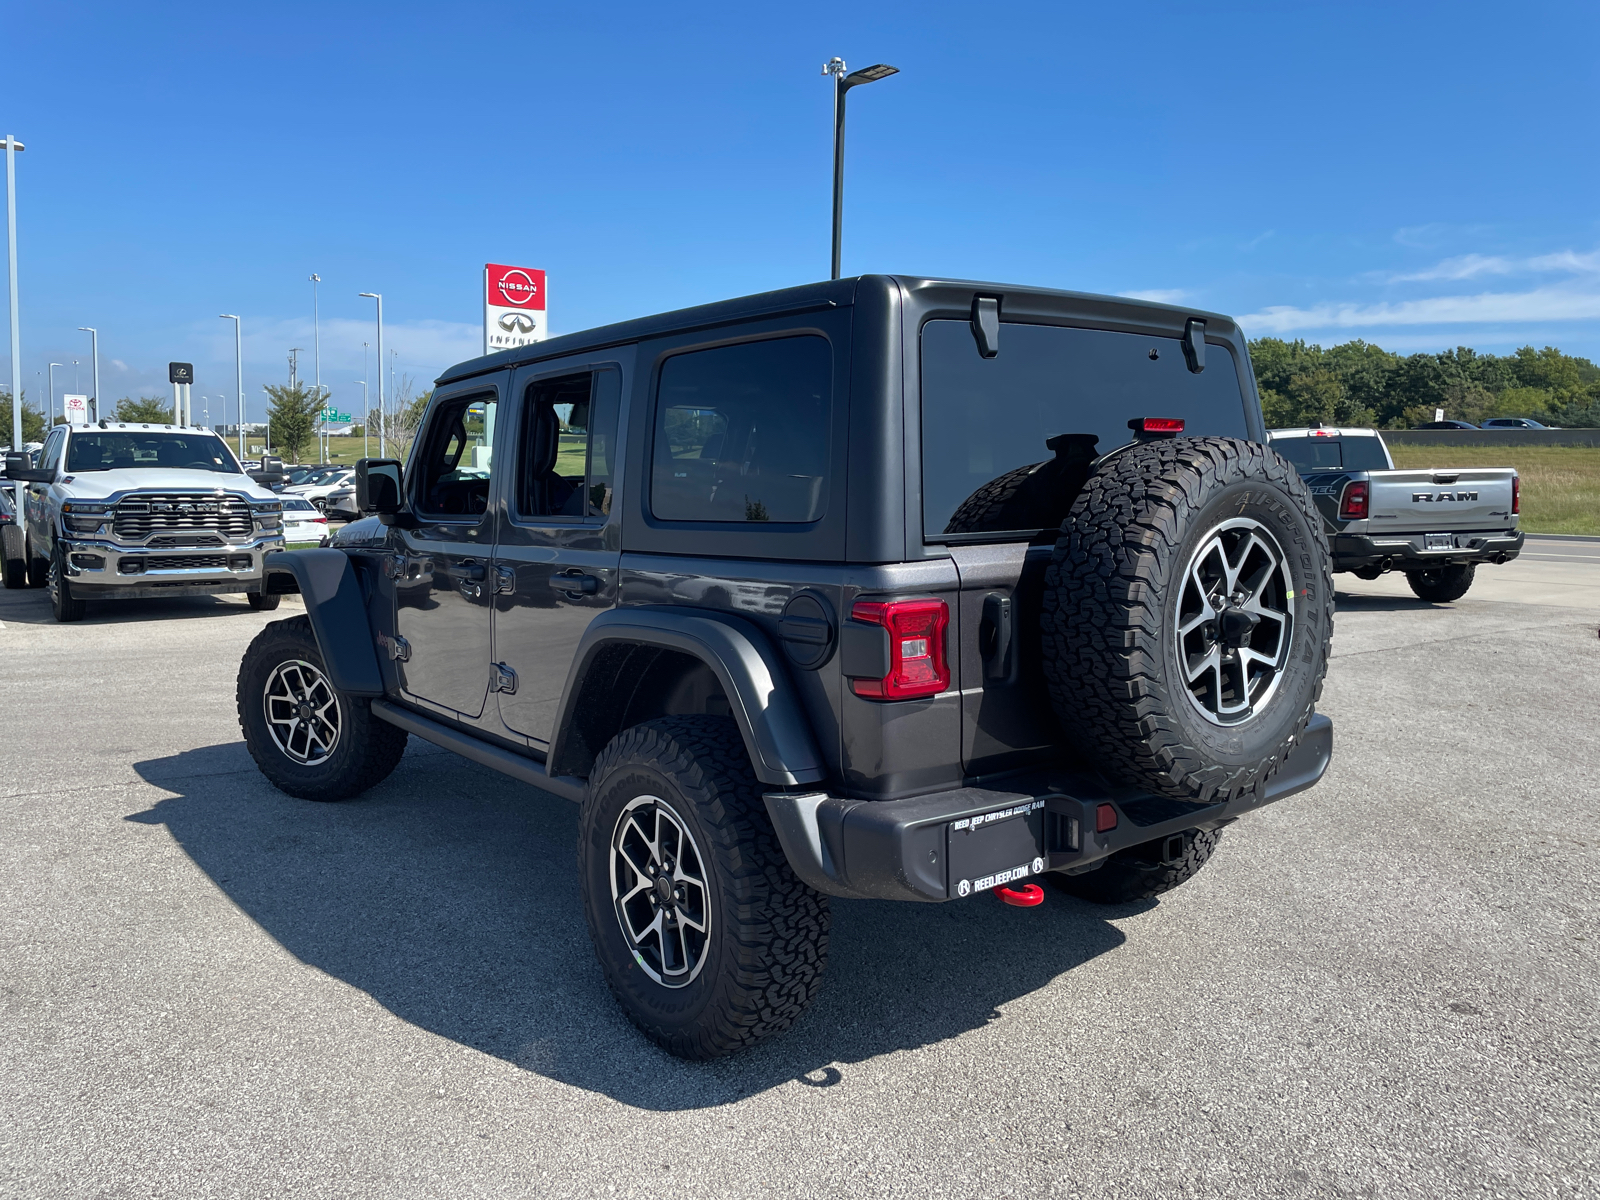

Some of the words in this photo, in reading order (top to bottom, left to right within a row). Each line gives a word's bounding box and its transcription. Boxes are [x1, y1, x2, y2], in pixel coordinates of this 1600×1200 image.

[498, 282, 537, 292] NISSAN
[490, 335, 538, 346] INFINI
[1309, 486, 1337, 494] BEL
[1412, 491, 1478, 502] RAM
[152, 503, 218, 512] RAM
[1234, 489, 1316, 602] All-Terrain
[376, 630, 388, 648] Jee
[954, 819, 969, 831] REED
[970, 815, 984, 826] JEEP
[985, 808, 1013, 822] CHRYSLER
[1013, 804, 1031, 814] DODGE
[1031, 800, 1045, 810] RAM
[974, 865, 1029, 892] REEDJEEP.COM
